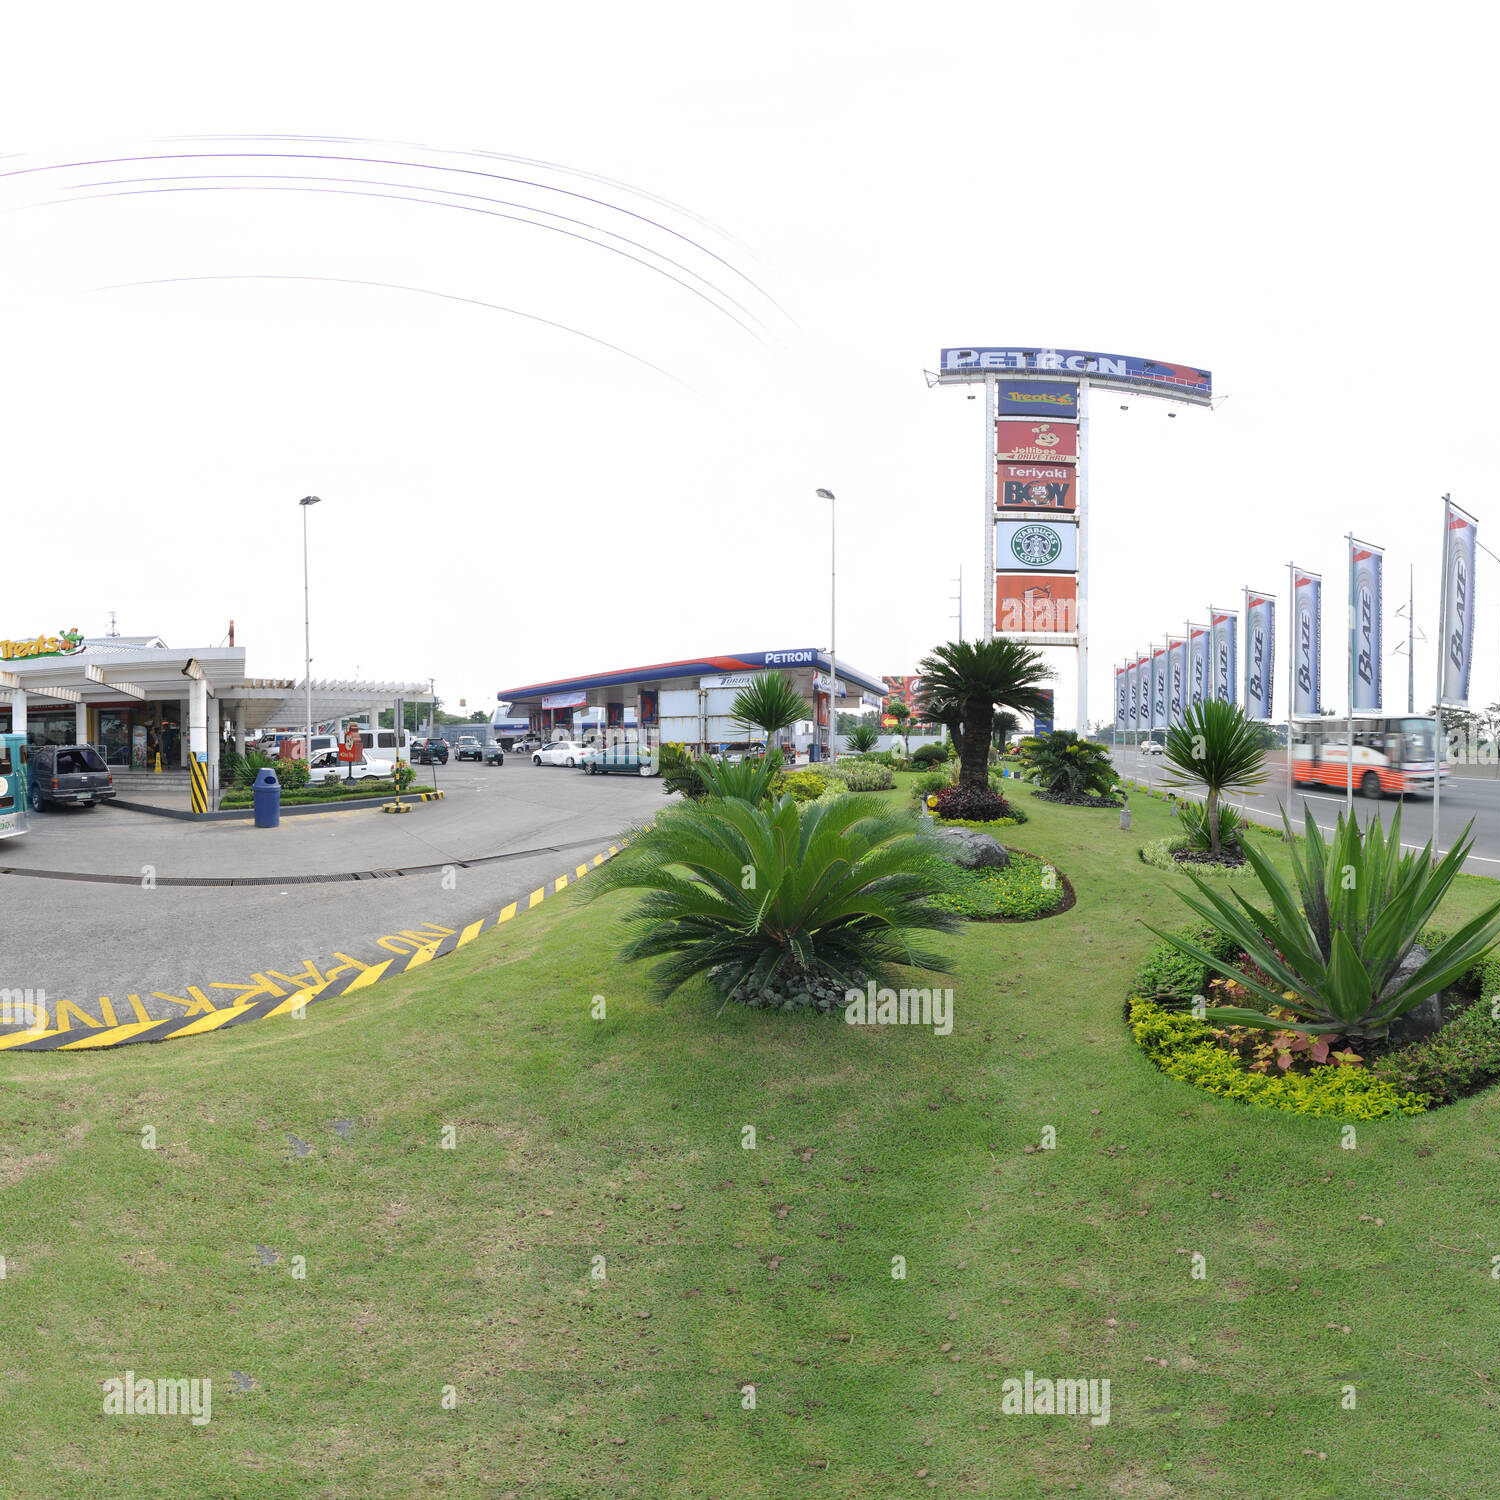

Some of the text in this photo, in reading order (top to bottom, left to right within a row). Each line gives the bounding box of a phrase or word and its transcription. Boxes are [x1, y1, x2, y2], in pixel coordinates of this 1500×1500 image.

[947, 350, 1126, 375] PETRON
[1008, 391, 1056, 401] Treats
[1011, 446, 1057, 454] Jollibee
[1008, 467, 1067, 478] Teriyaki
[1016, 528, 1057, 545] STARBUCKS
[1020, 552, 1052, 564] COFFEE
[1451, 561, 1467, 672] BLAZE
[0, 635, 59, 659] Treats
[1358, 589, 1373, 685] BLAZE
[765, 651, 812, 664] PETRON
[1250, 629, 1263, 701] BLAZE
[1298, 613, 1311, 695] BLAZE
[1141, 678, 1149, 719] BLAZE
[1156, 671, 1166, 717] BLAZE
[1171, 665, 1181, 716] BLAZE
